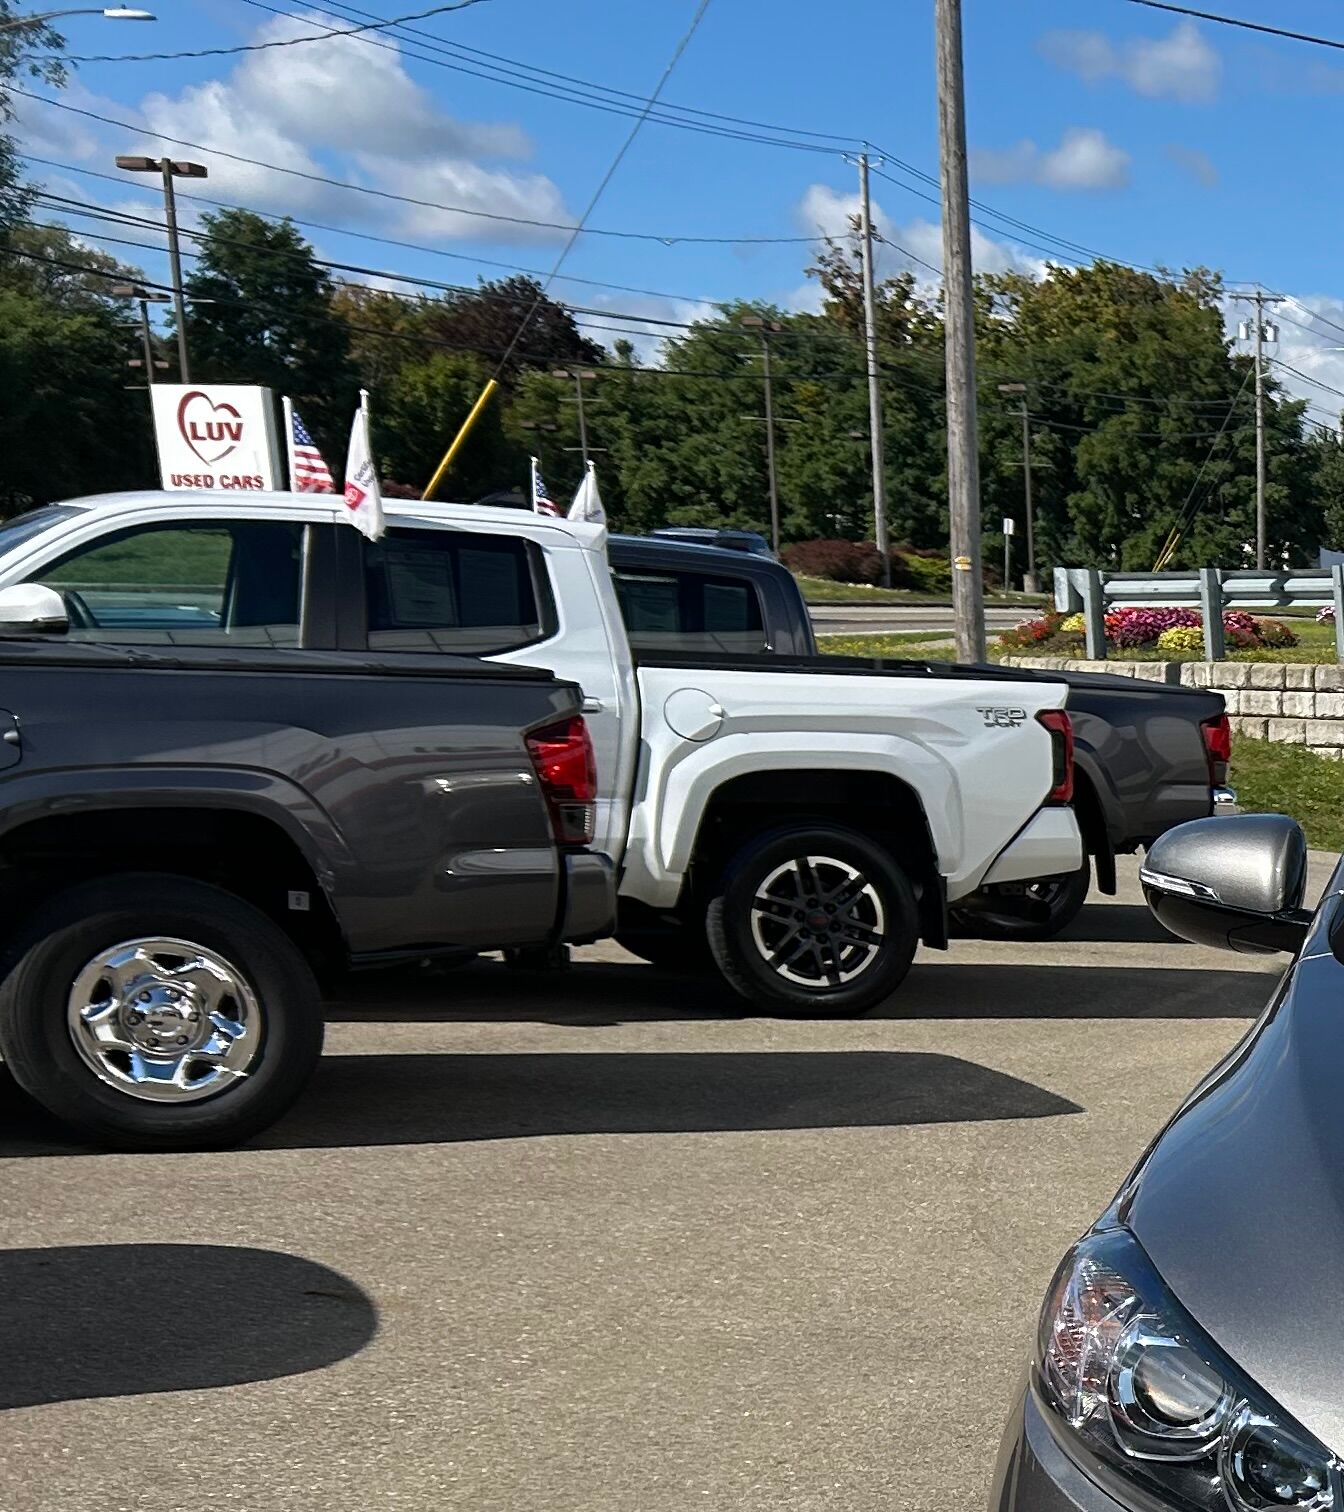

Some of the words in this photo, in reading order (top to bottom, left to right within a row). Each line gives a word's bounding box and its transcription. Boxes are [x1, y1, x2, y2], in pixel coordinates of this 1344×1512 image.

[189, 422, 244, 442] LUV
[170, 473, 215, 489] USED
[218, 474, 265, 490] CARS
[976, 706, 1027, 723] TRD
